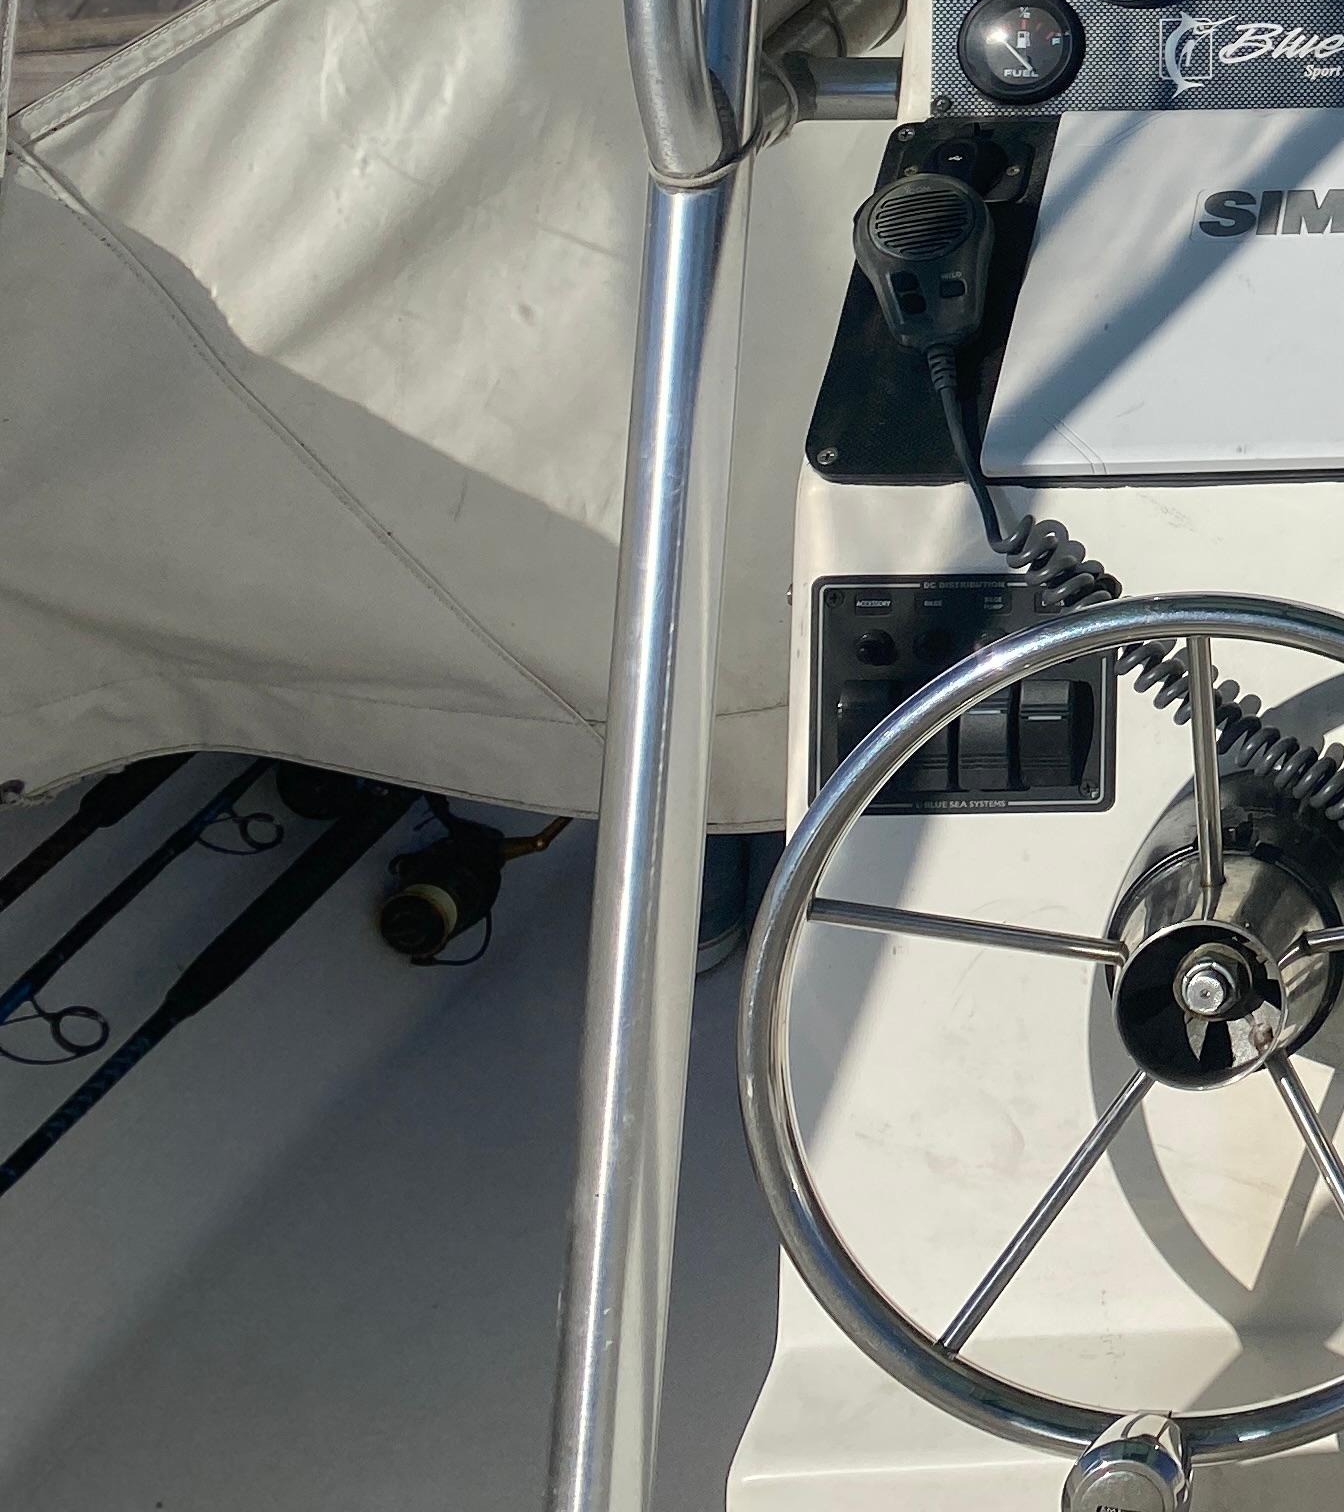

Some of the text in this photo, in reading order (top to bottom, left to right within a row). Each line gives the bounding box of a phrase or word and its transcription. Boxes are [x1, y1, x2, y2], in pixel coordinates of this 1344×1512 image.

[1004, 69, 1039, 78] FUEL
[1303, 64, 1342, 80] Sport
[923, 580, 1005, 589] DC DISTRIBUTION
[924, 799, 1006, 808] BLUE SEA SYSTEMS
